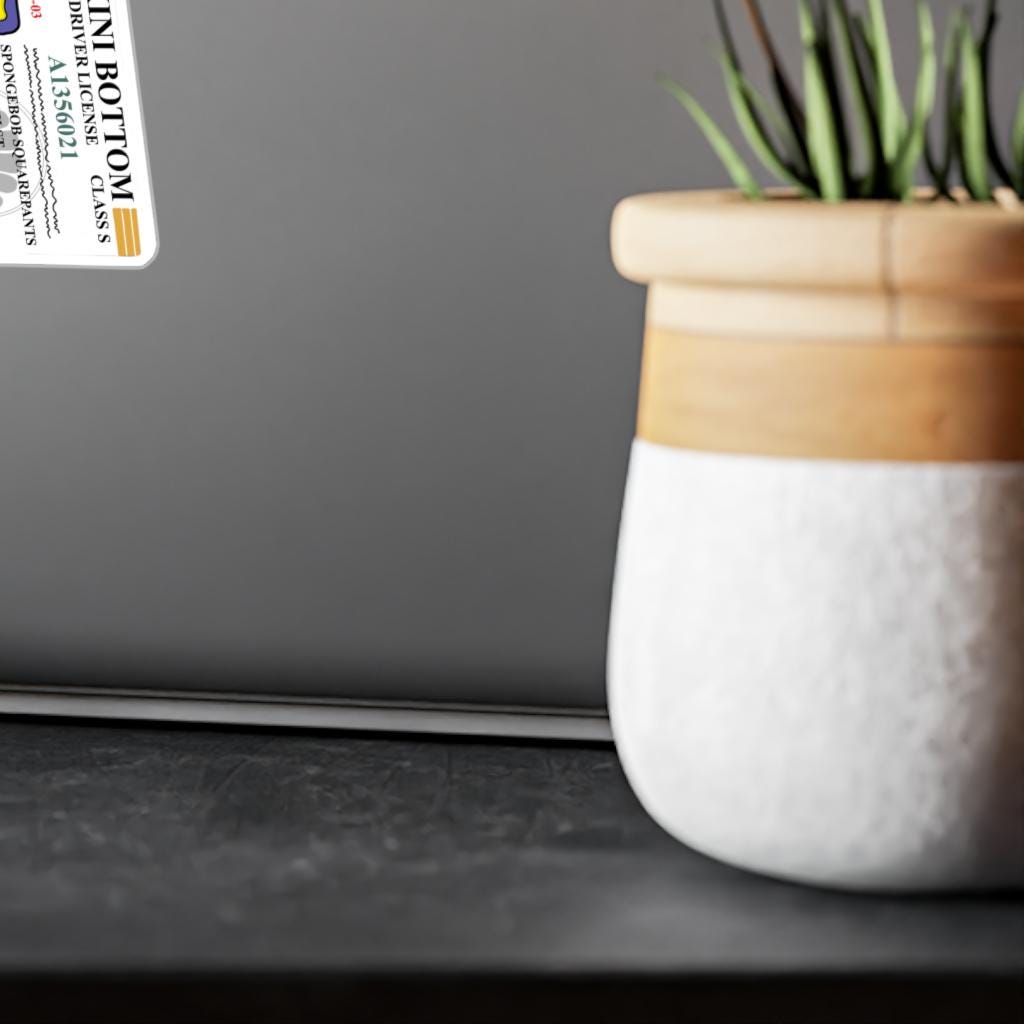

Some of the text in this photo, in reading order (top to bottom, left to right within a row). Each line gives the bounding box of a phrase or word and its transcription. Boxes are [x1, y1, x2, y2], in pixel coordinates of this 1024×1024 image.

[48, 56, 78, 159] A1356021
[68, 0, 98, 145] DRIVER LICENSE
[94, 60, 134, 202] BOTTOM
[0, 44, 37, 246] SPONGEBOB SQUAREPANTS
[90, 175, 111, 243] CLASS S
